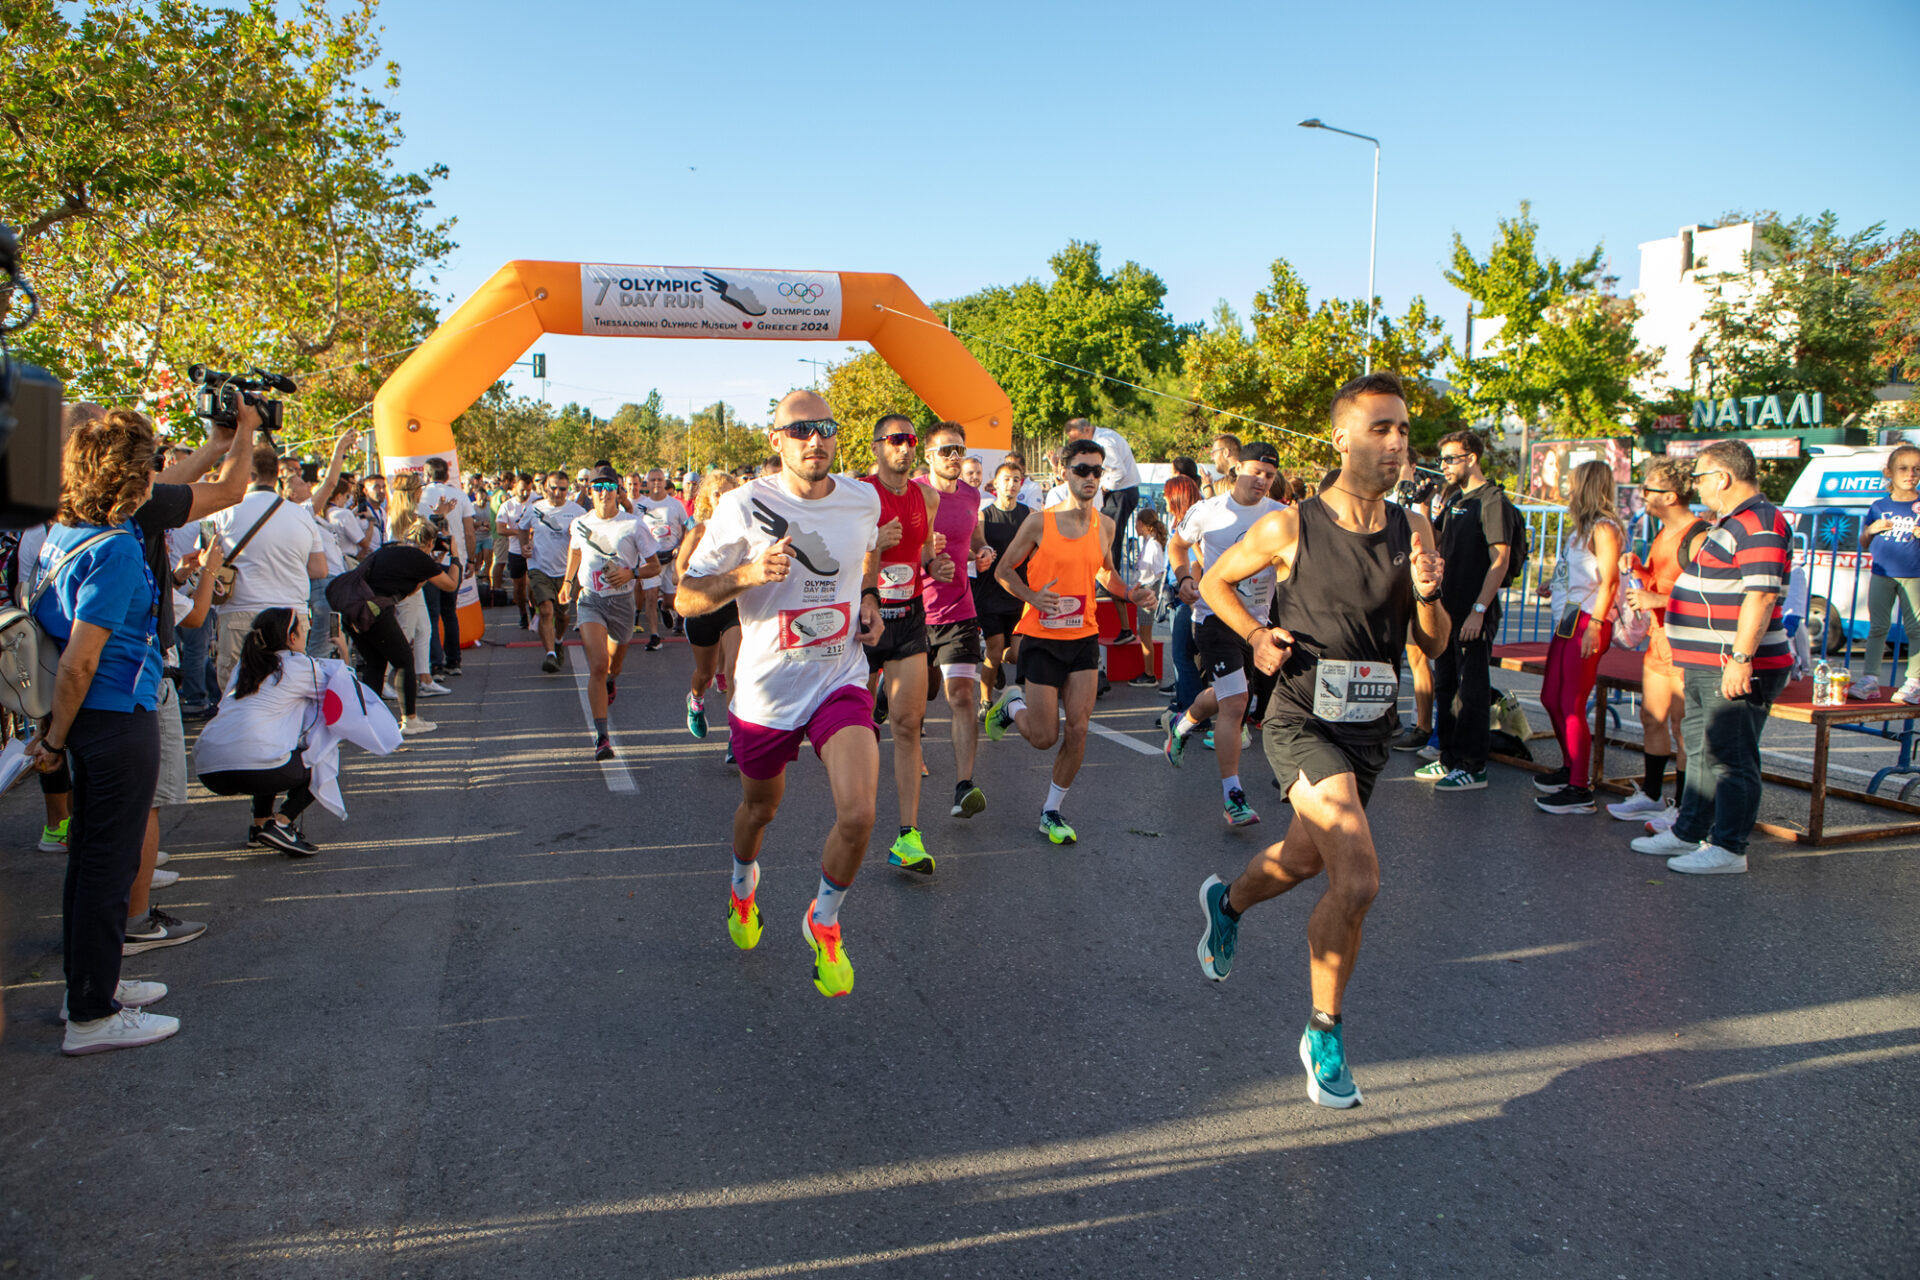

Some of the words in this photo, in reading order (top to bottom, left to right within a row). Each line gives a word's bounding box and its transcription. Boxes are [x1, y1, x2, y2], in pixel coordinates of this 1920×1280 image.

[619, 278, 703, 293] OLYMPIC
[619, 292, 658, 308] DAY
[663, 294, 704, 308] RUN
[771, 307, 811, 316] OLYMPIC
[813, 308, 831, 317] DAY
[594, 316, 658, 328] THESSALONIKI
[661, 318, 698, 328] OLYMPIC
[701, 320, 738, 330] MUSEUM
[757, 321, 798, 331] GREECE
[801, 322, 829, 331] 2024
[1354, 684, 1393, 696] 10150
